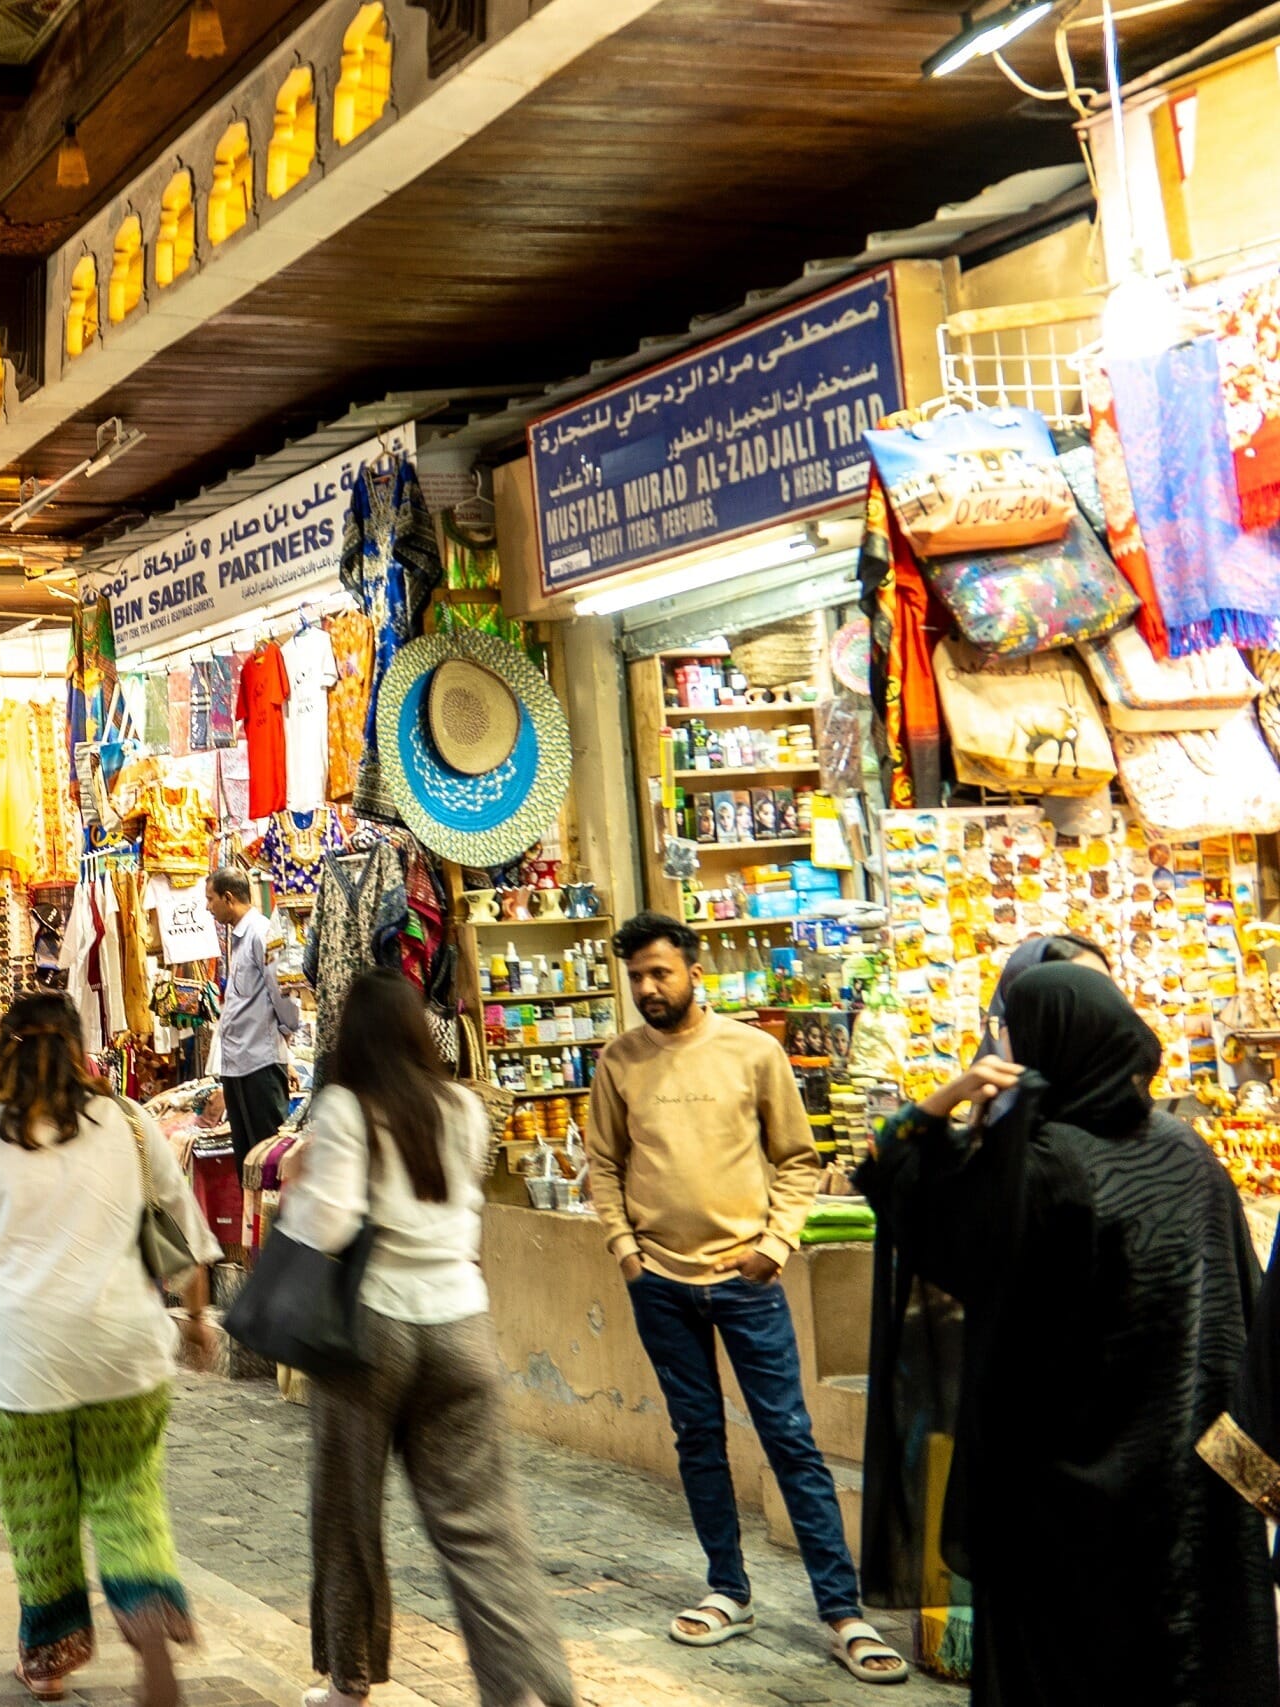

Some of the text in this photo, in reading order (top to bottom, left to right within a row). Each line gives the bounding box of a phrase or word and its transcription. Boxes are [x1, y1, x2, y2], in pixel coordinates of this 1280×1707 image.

[757, 299, 880, 372] مصطفى
[707, 351, 754, 386] مراد
[540, 403, 612, 456] للتجارة
[545, 487, 619, 545] MUSTAFA
[623, 463, 688, 519] MURAD
[696, 416, 817, 494] AL-ZADJALI
[218, 517, 261, 555] صابر
[263, 502, 289, 535] بن
[590, 526, 624, 563] BEAUTY
[793, 458, 833, 499] HERBS
[114, 596, 143, 630] BIN
[148, 570, 207, 616] SABIR
[218, 517, 335, 589] PARTNERS
[200, 538, 212, 559] و
